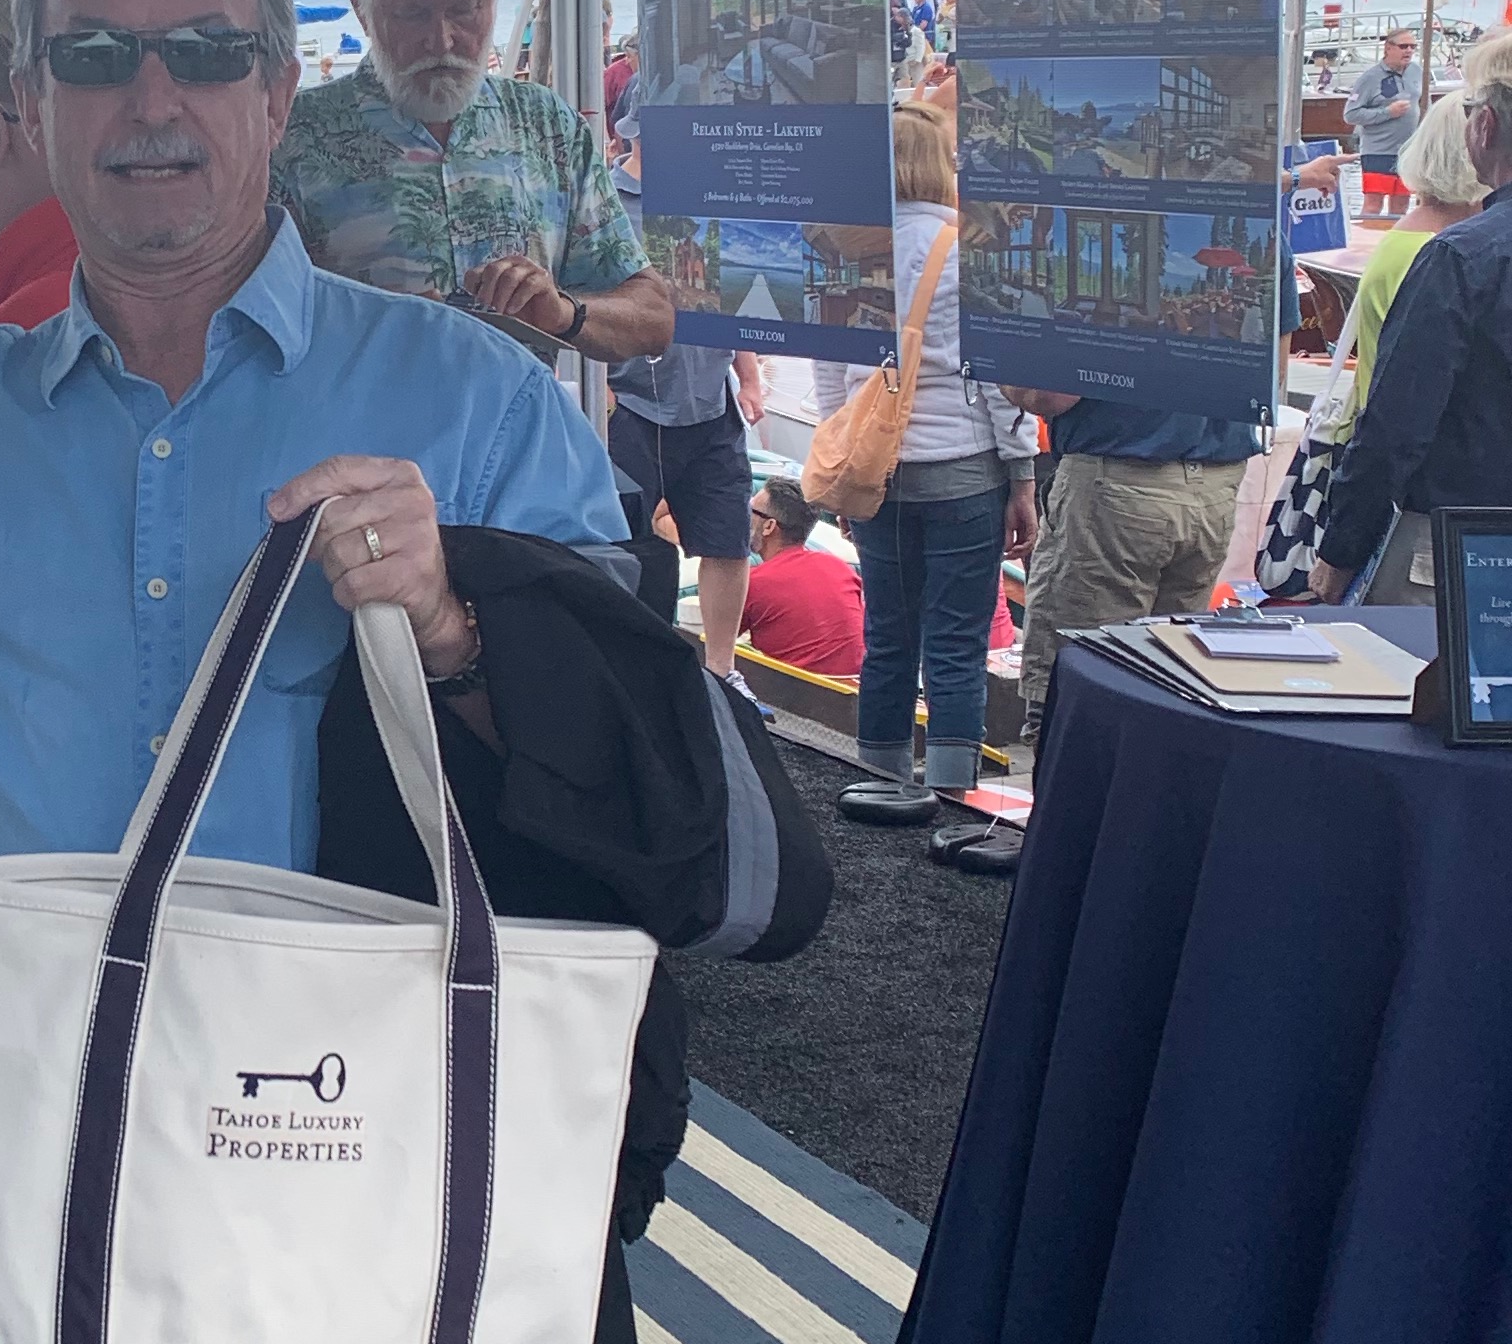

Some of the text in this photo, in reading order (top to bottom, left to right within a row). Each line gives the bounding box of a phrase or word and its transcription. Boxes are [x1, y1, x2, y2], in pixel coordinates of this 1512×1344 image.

[692, 122, 721, 136] RELAX
[723, 125, 734, 136] IN
[736, 122, 763, 136] STYLE
[774, 123, 823, 136] LAKEVIEW
[1294, 197, 1332, 210] Gate
[739, 328, 785, 343] TLUXP.COM
[1077, 369, 1135, 388] TLUXP.COM
[1479, 612, 1512, 628] throug
[211, 1107, 364, 1131] TAHOE LUXURY
[207, 1133, 363, 1162] PROPERTIES
